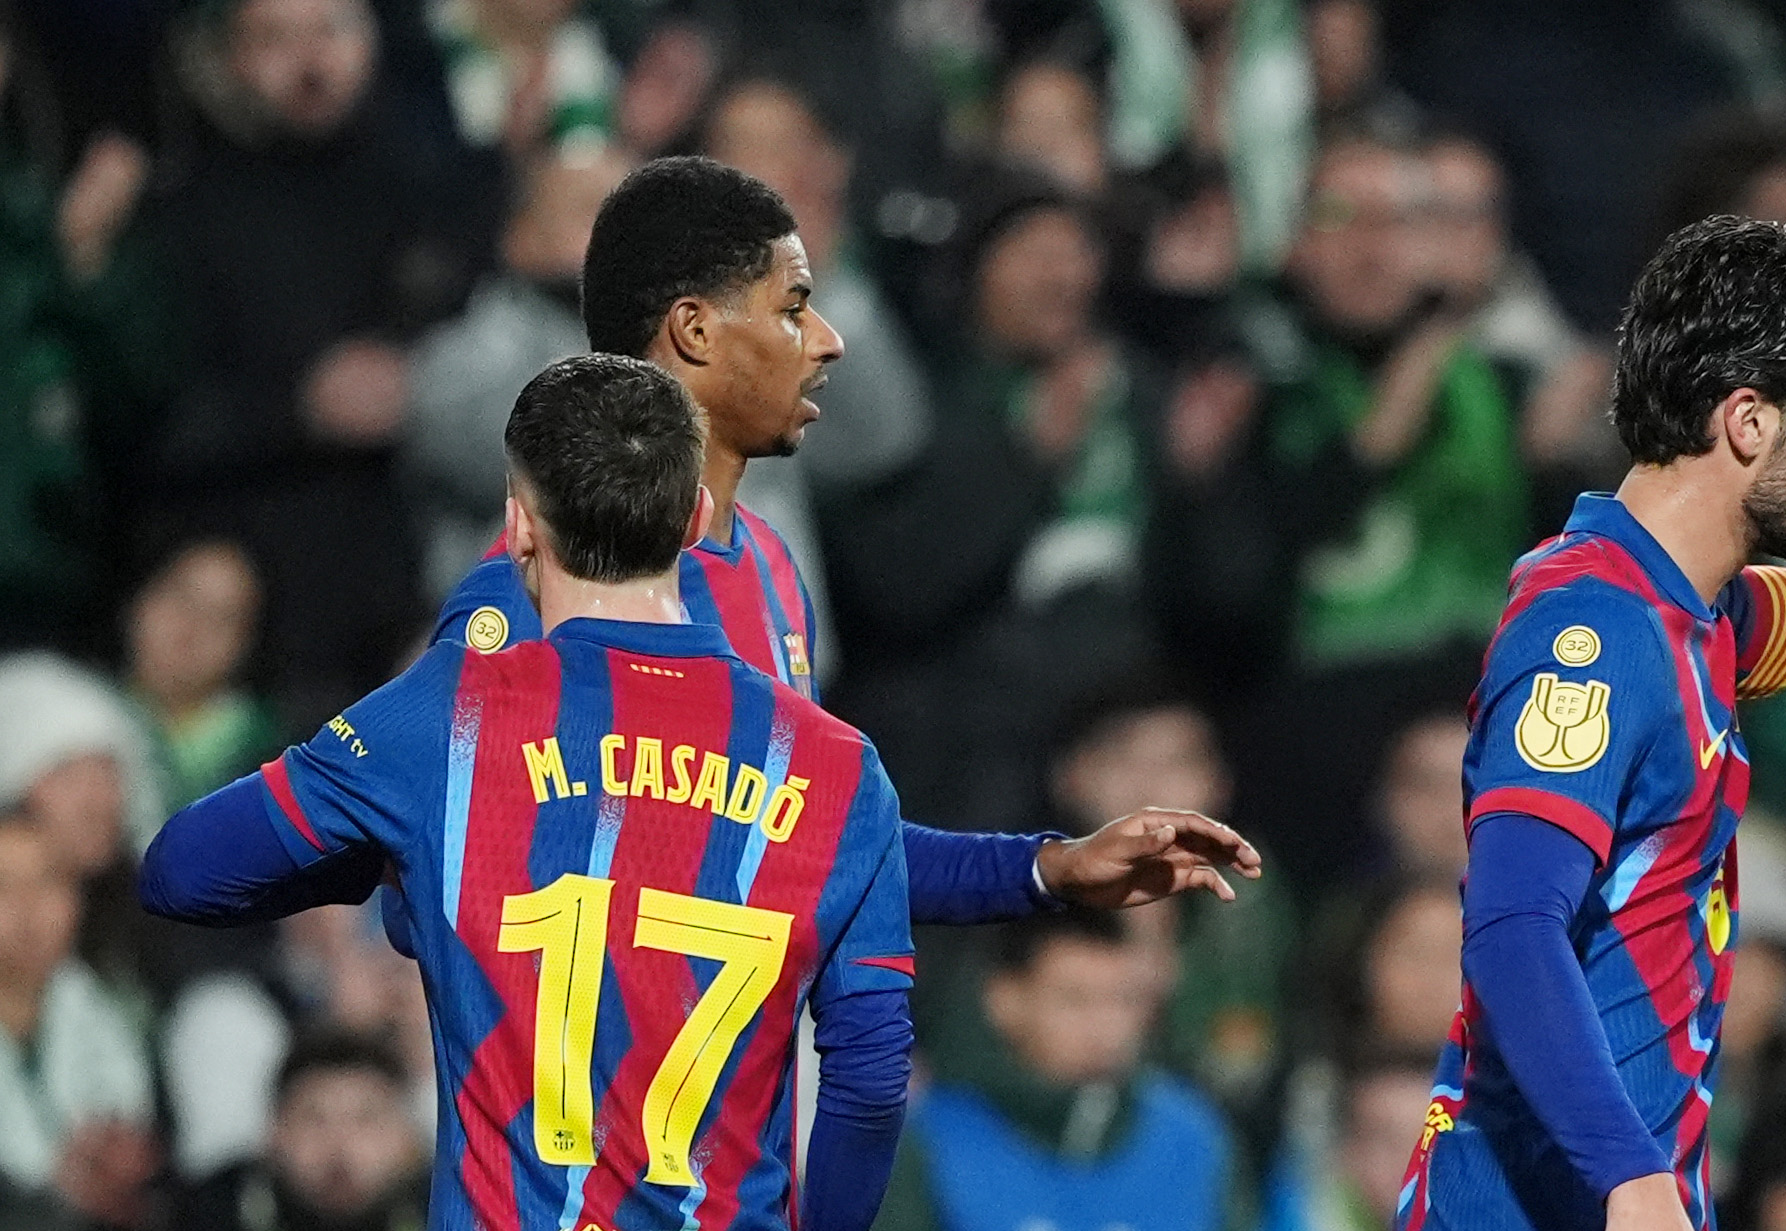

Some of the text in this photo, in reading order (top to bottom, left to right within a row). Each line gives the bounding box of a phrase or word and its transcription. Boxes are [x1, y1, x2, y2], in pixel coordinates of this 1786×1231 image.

[475, 621, 498, 640] 32
[1564, 639, 1589, 653] 32
[521, 733, 811, 843] M. CASADÓ
[497, 872, 795, 1188] 17
